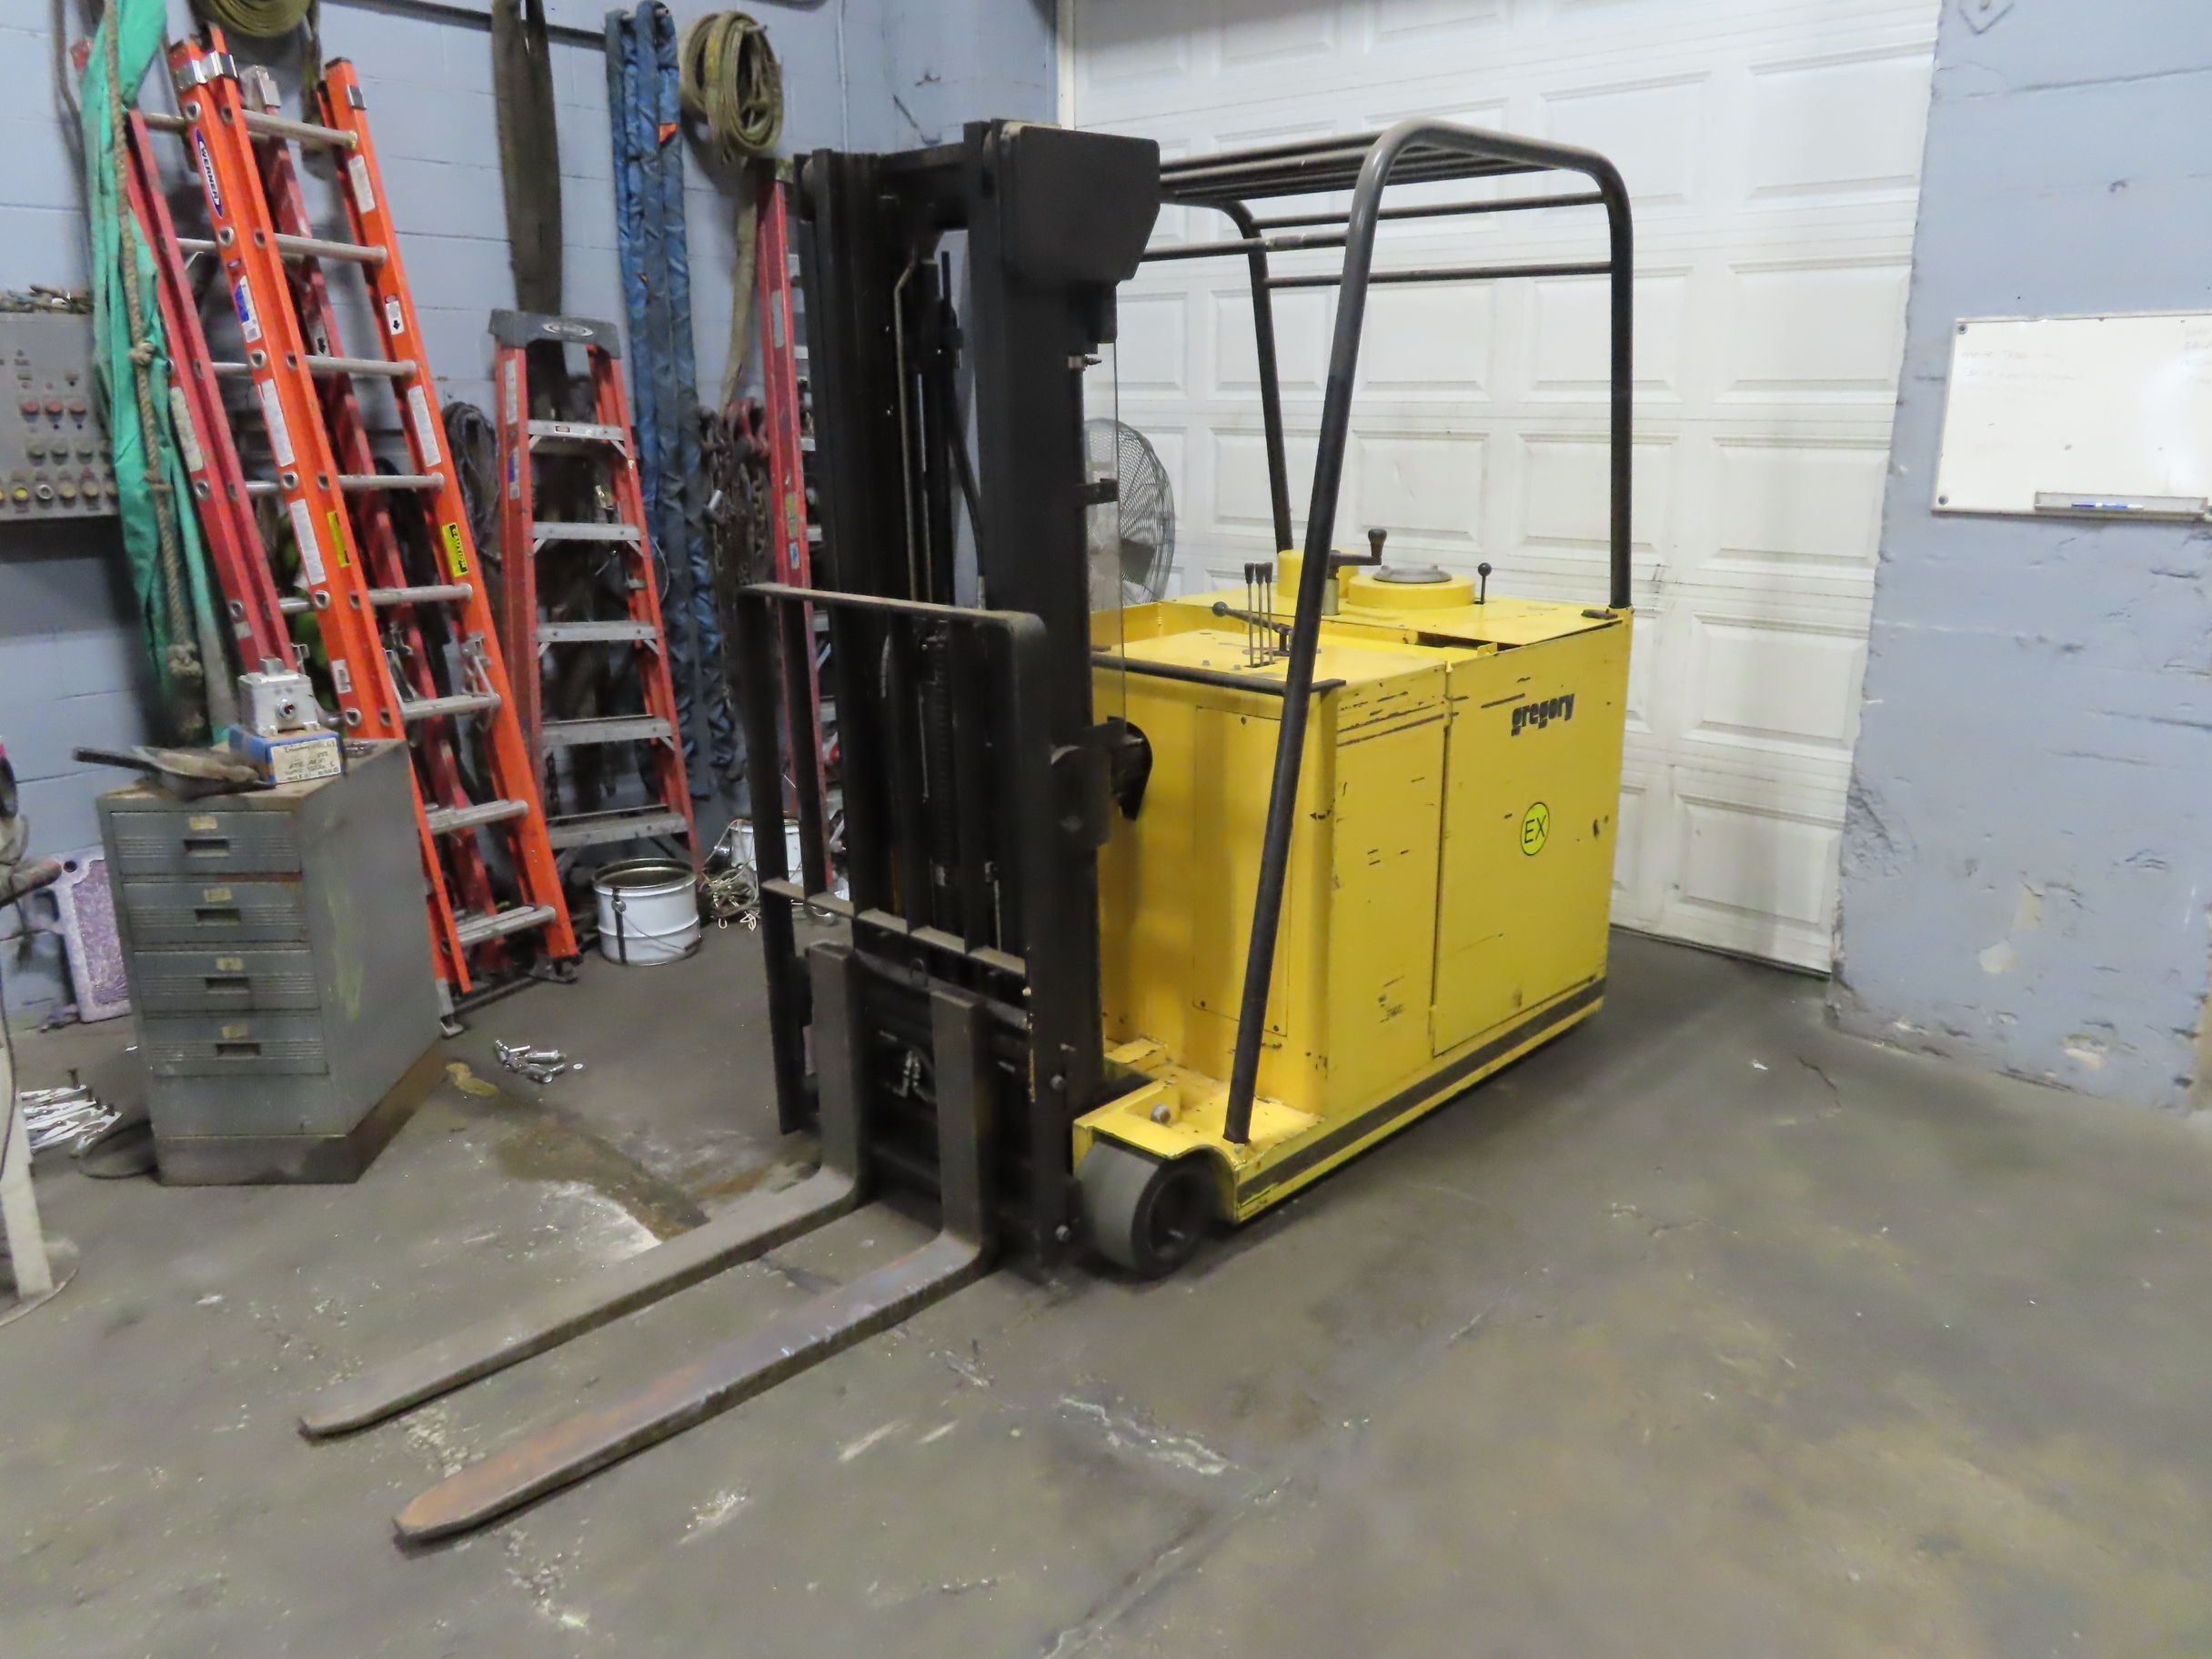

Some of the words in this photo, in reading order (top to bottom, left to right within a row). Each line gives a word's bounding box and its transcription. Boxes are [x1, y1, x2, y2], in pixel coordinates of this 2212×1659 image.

[200, 147, 219, 199] WERNER
[1511, 693, 1575, 737] gregory
[1523, 815, 1547, 844] EX
